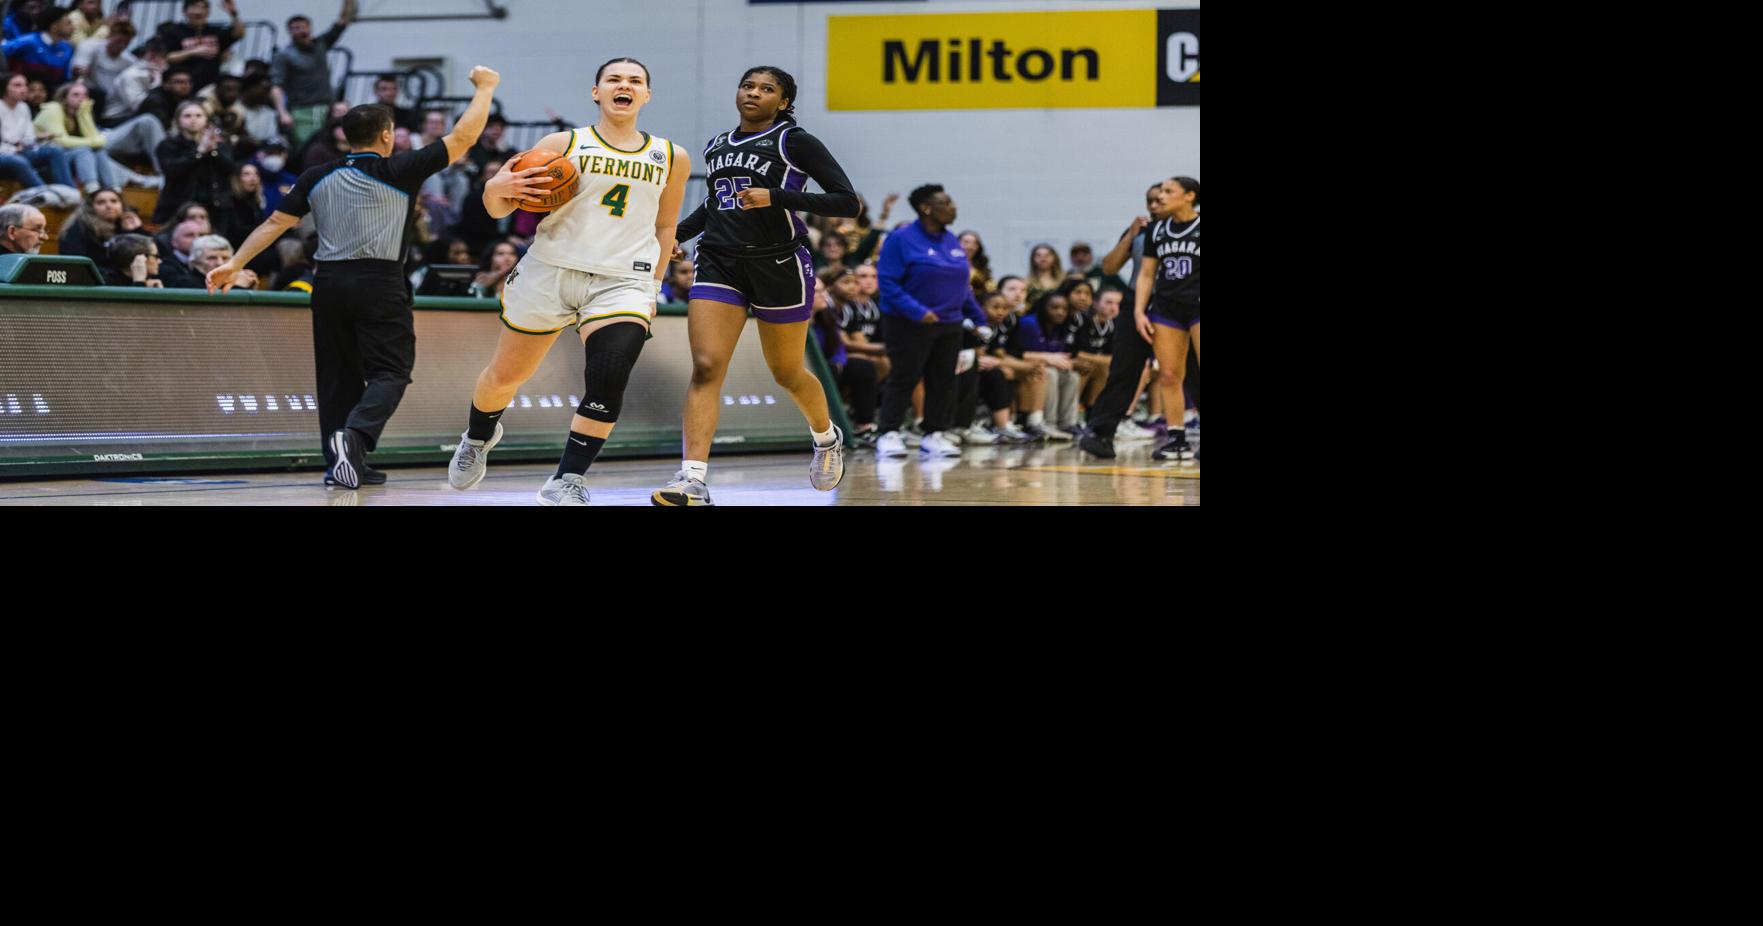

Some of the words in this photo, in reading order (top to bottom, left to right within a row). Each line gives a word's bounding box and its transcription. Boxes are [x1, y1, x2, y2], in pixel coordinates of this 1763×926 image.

[882, 38, 1099, 84] Milton
[579, 155, 664, 186] VERMONT
[601, 183, 631, 218] 4
[46, 270, 67, 284] POSS
[1163, 256, 1193, 280] 20
